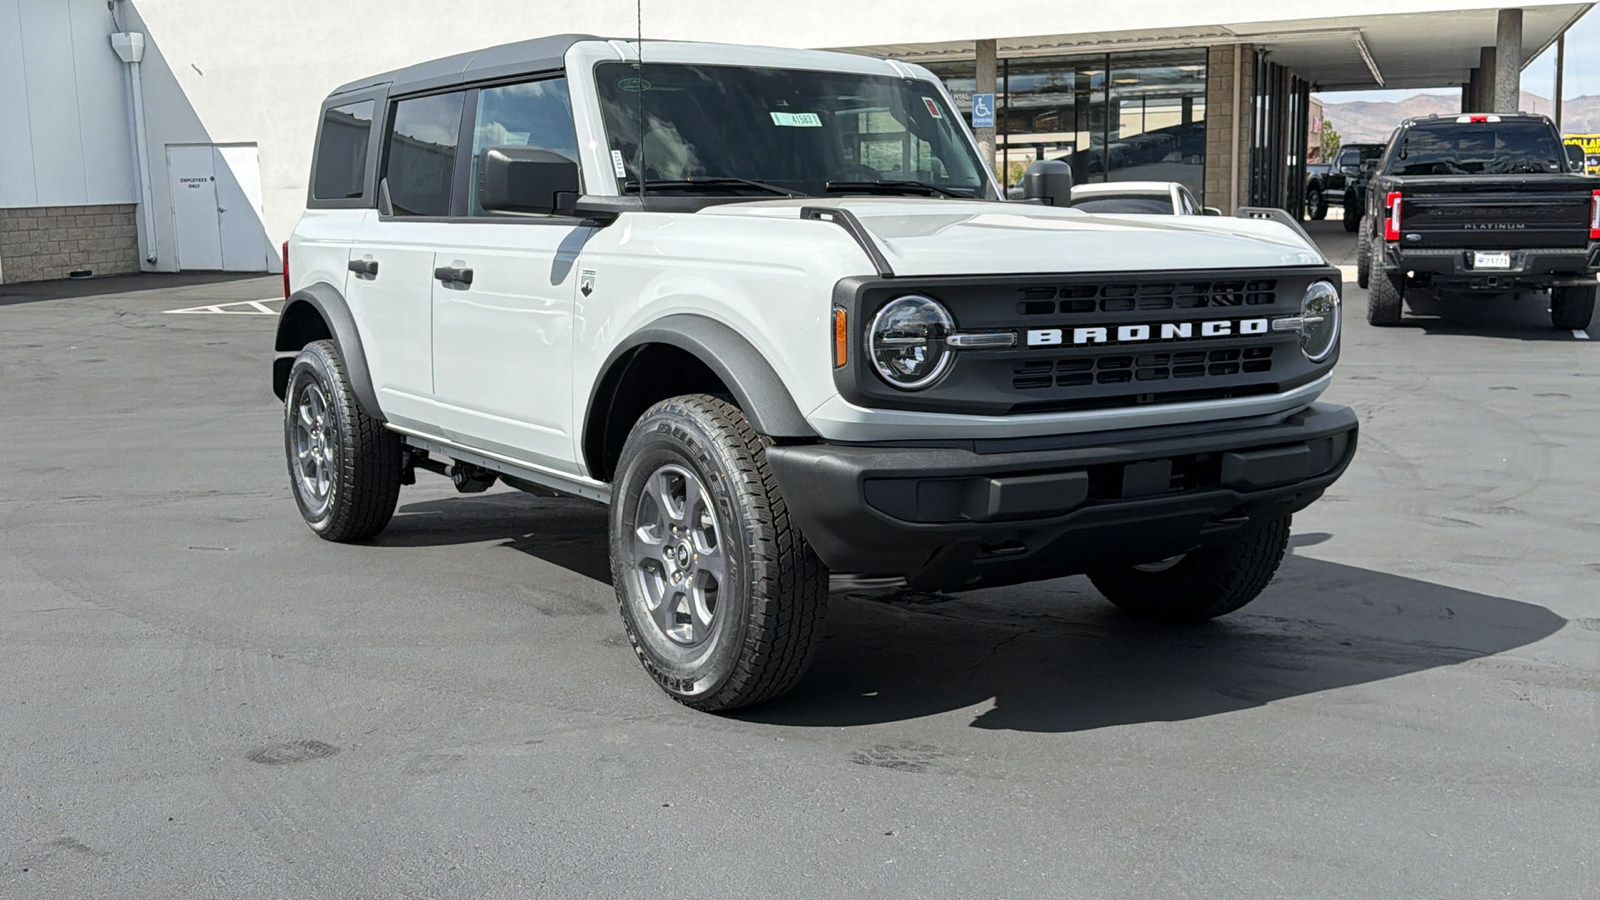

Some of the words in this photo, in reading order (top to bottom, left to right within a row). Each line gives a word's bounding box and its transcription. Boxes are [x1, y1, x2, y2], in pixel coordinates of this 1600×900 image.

[791, 114, 813, 124] 41583
[1026, 318, 1269, 346] BRONCO
[656, 422, 735, 525] DUELER
